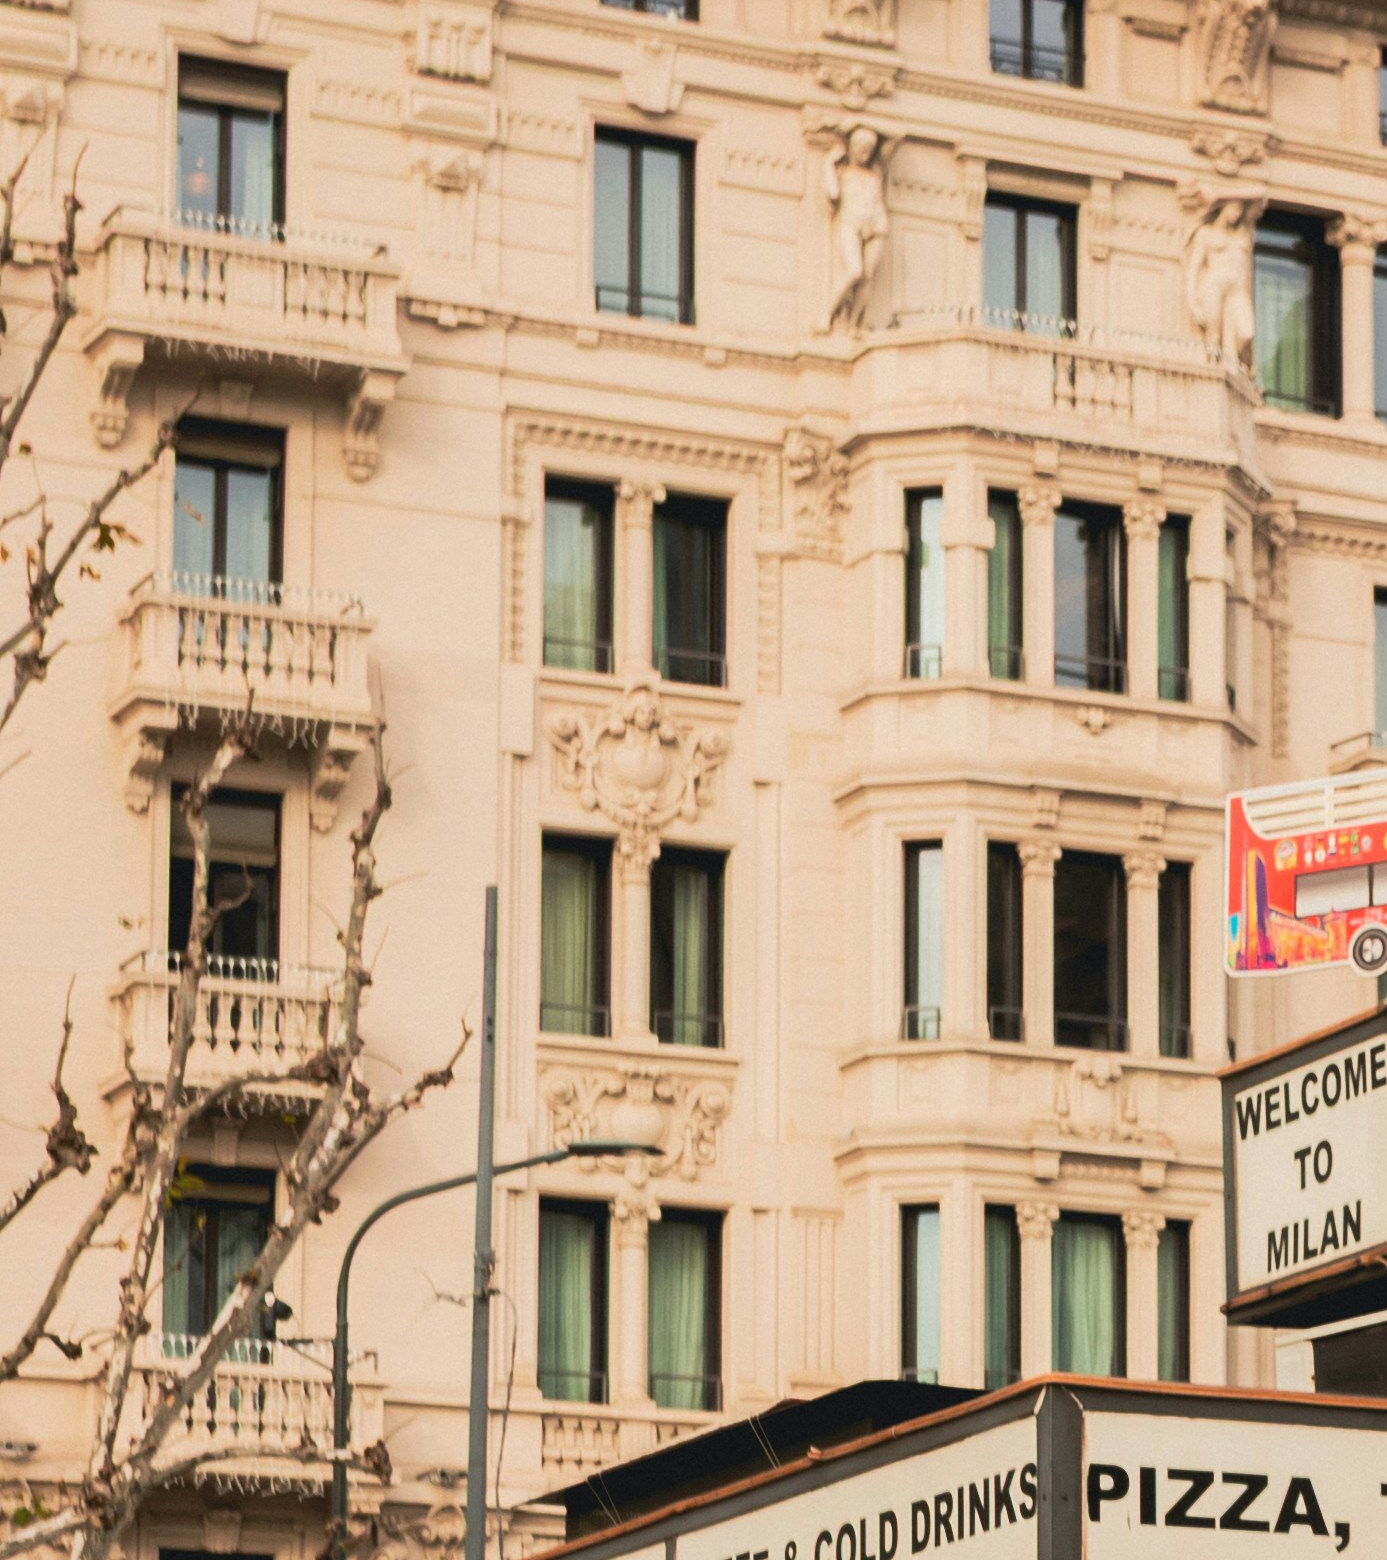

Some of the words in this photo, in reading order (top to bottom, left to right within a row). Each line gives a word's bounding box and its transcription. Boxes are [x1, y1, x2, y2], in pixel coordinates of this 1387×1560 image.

[1235, 1044, 1387, 1140] WELCOME
[1294, 1139, 1333, 1190] TO
[1266, 1200, 1363, 1273] MILAN
[911, 1462, 1038, 1556] DRINKS
[1086, 1464, 1352, 1552] PIZZA,
